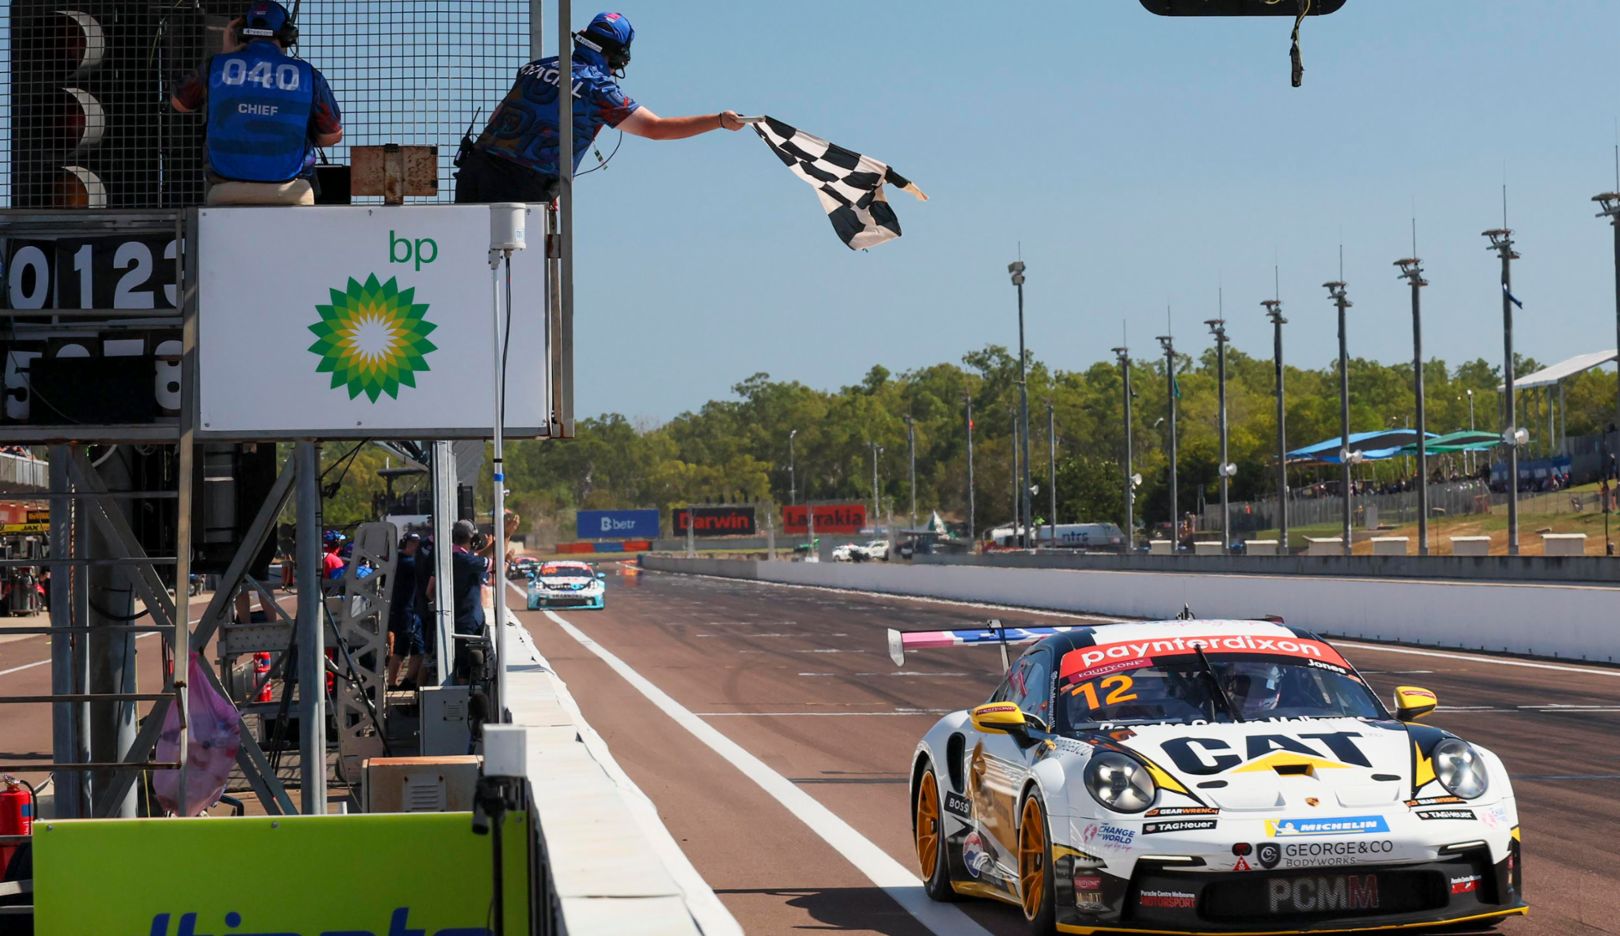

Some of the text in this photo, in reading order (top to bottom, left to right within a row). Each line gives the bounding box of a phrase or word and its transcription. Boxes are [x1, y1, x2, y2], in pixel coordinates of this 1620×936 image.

[222, 59, 299, 91] 040
[238, 103, 278, 116] CHIEF
[390, 230, 438, 271] bp
[613, 519, 636, 530] betr
[1081, 635, 1321, 668] paynterdixon
[1308, 659, 1346, 674] Jones
[1071, 674, 1138, 711] 12
[1160, 732, 1373, 775] CAT
[949, 798, 970, 813] BOSS
[1099, 825, 1136, 838] CHANGE
[1300, 821, 1377, 831] MICHELIN
[1102, 834, 1132, 844] WORLD
[1286, 840, 1393, 857] GEORGE&CO
[1286, 857, 1356, 867] BODYWORKS
[1269, 874, 1381, 912] PCMM
